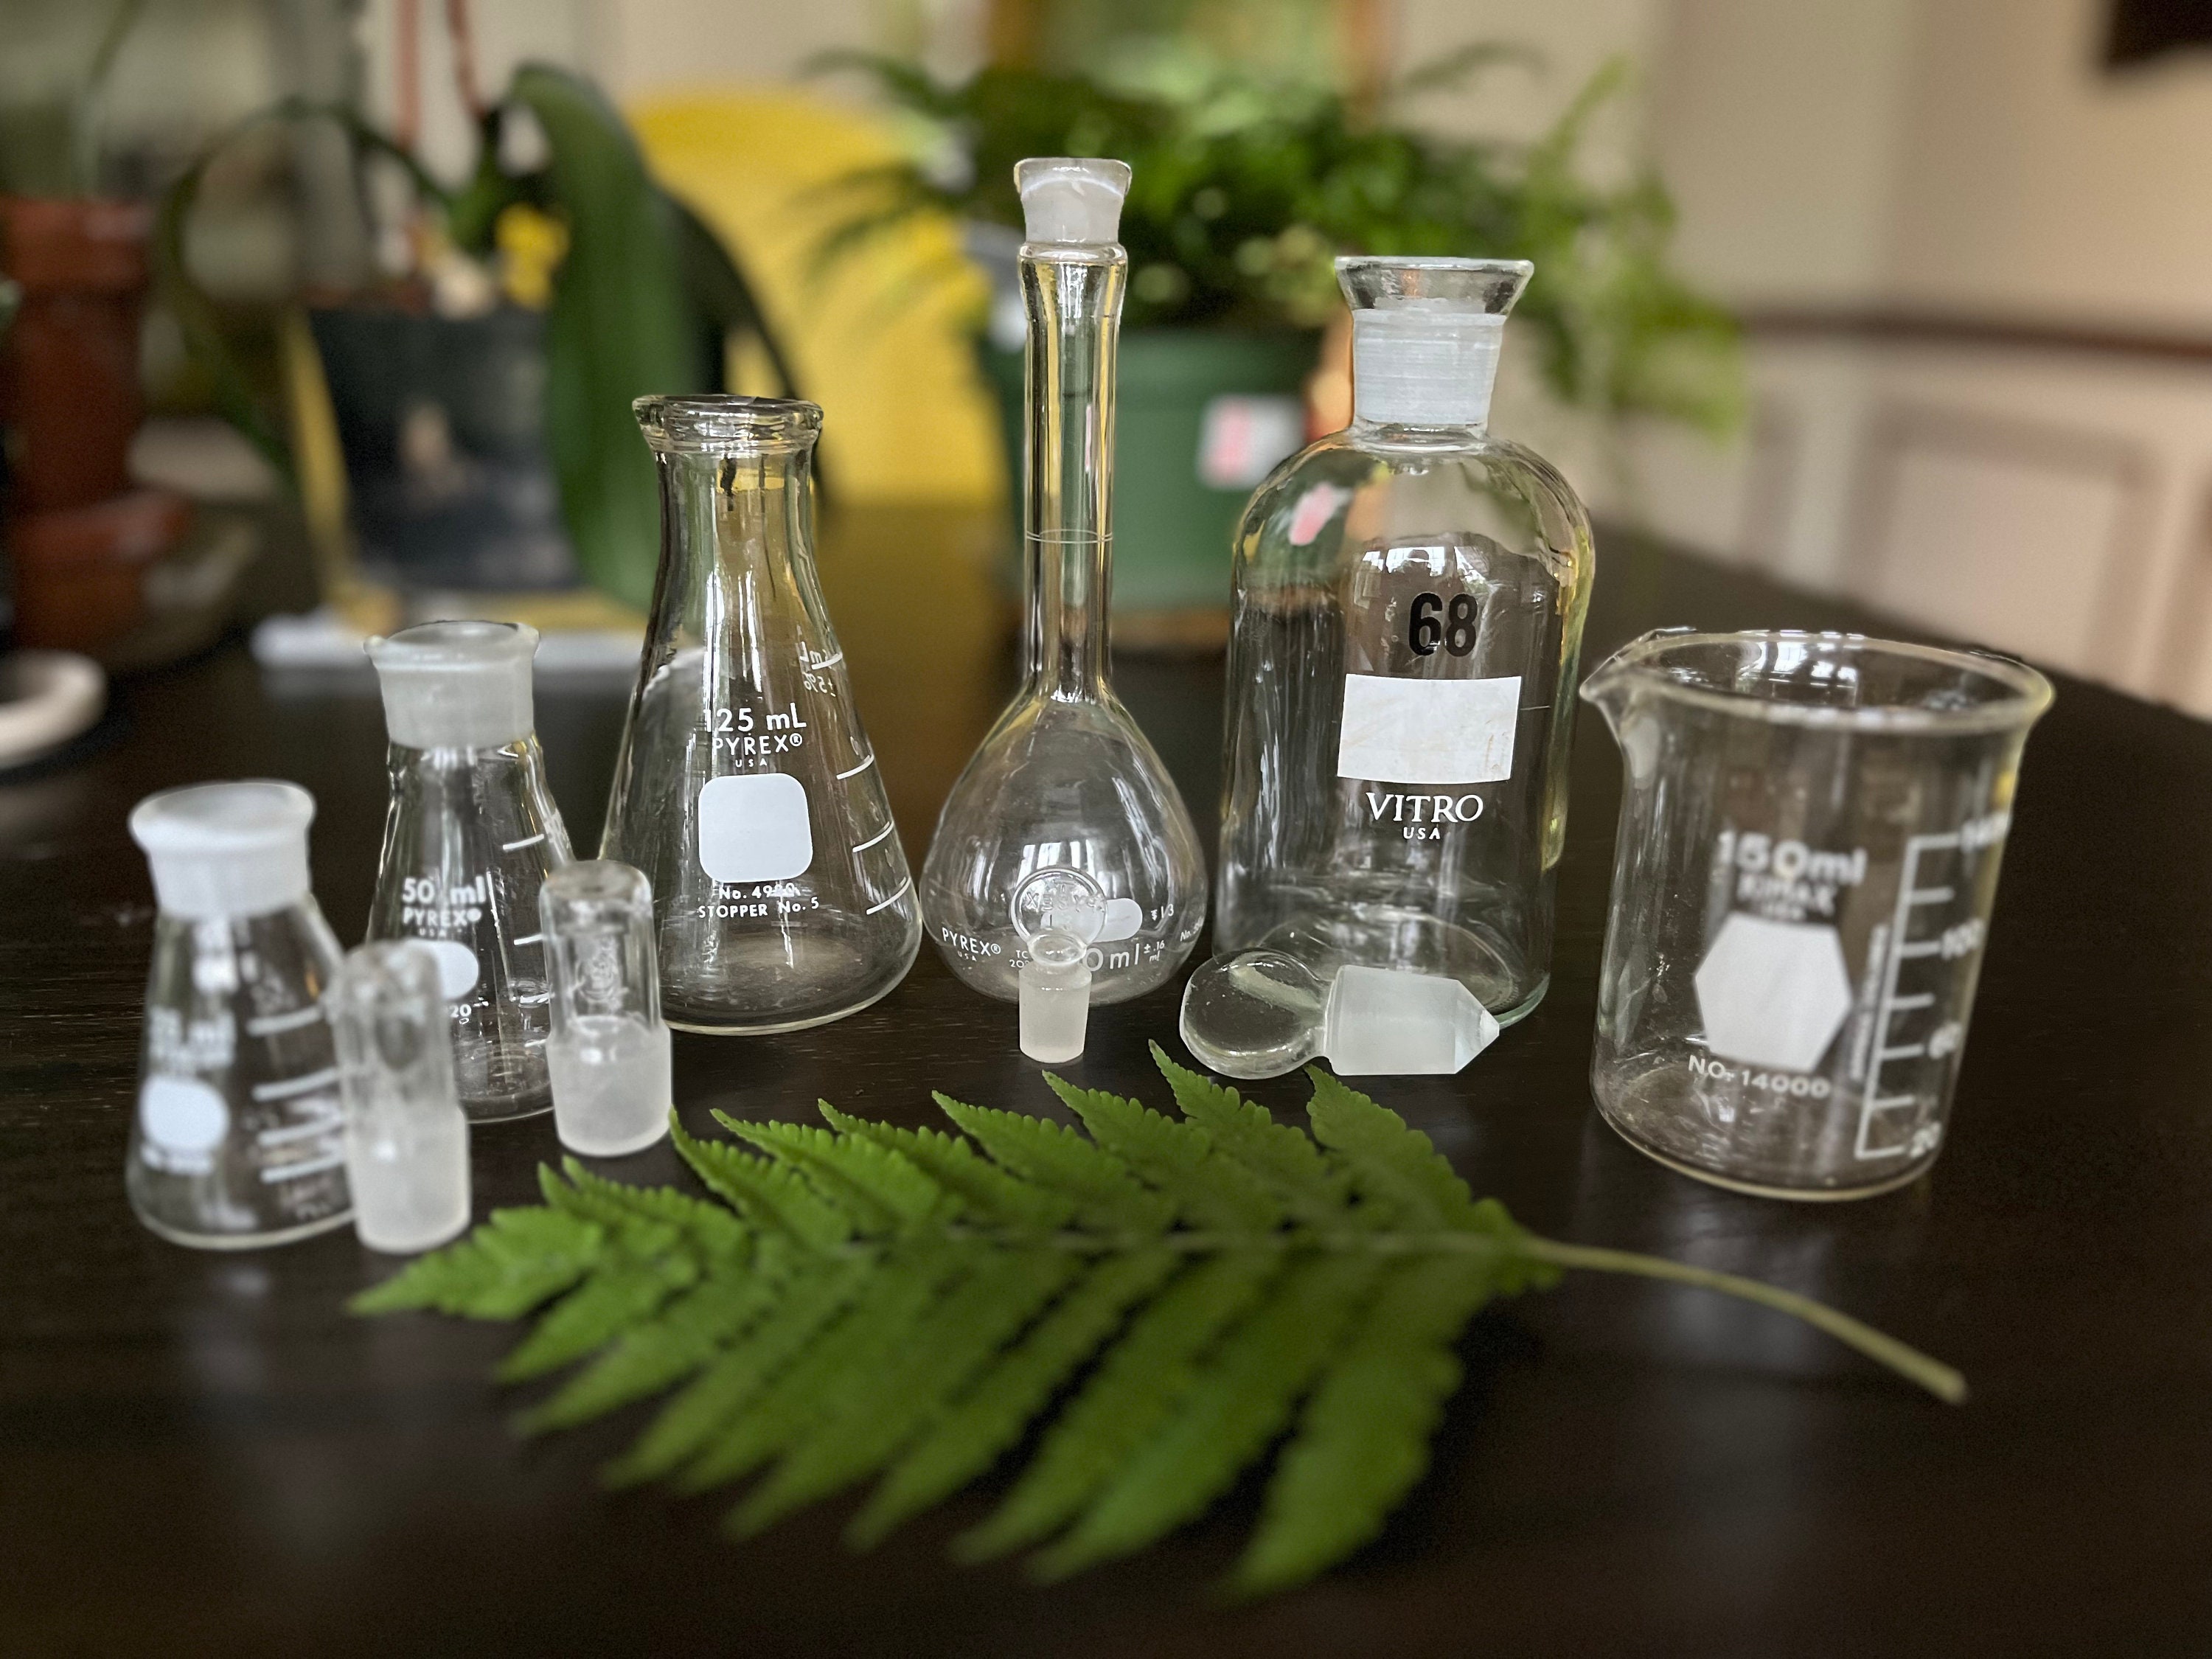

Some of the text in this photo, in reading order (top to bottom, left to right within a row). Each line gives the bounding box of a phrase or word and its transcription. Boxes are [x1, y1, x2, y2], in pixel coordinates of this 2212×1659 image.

[1409, 592, 1478, 657] 68
[703, 702, 807, 732] 125 mL
[1366, 791, 1484, 823] VITRO
[1402, 827, 1441, 841] USA
[403, 875, 487, 905] 50 ml
[718, 886, 747, 900] No.
[698, 896, 820, 919] STOPPER No. 5
[445, 1004, 472, 1018] 20
[1742, 1070, 1832, 1099] 14000
